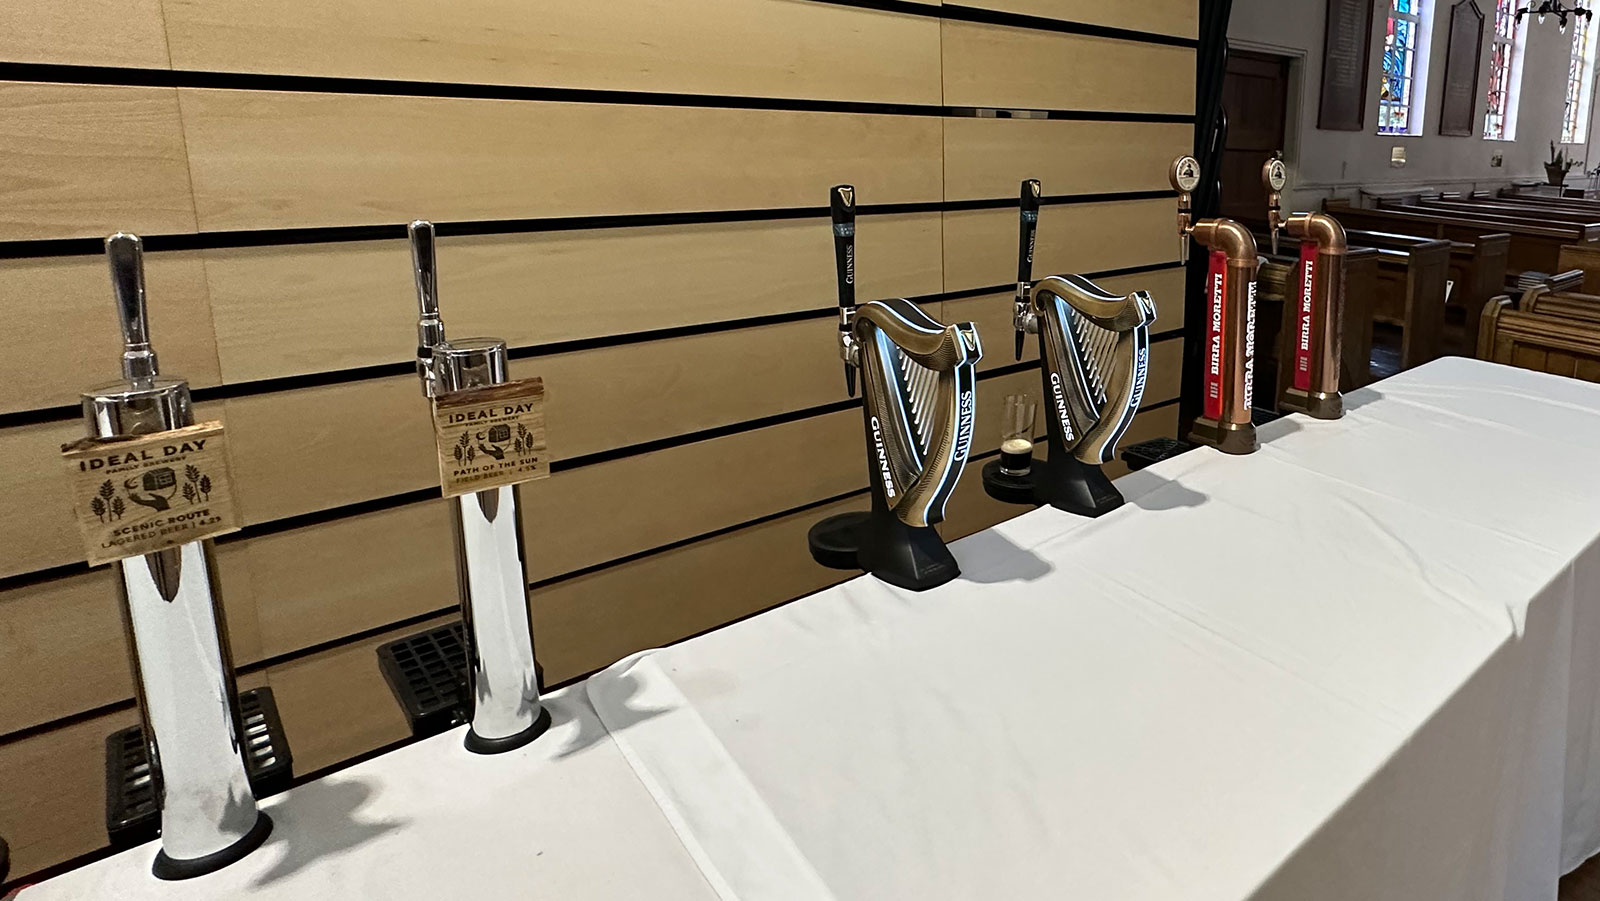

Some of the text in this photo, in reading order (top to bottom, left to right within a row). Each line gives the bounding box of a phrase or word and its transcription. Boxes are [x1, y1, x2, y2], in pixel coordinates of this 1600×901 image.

[846, 245, 854, 284] GUINNESS
[1213, 273, 1223, 332] MORETTI
[1303, 260, 1314, 313] MORETTI
[1301, 315, 1311, 351] BIRRA
[1211, 335, 1221, 375] BIRRA
[1130, 347, 1146, 408] GUINNESS
[449, 403, 534, 424] IDEAL DAY
[1050, 372, 1075, 442] GUINNESS
[954, 390, 972, 462] GUINNESS
[79, 439, 207, 472] IDEAL DAY
[106, 464, 140, 475] FAMILY
[453, 457, 538, 476] PATH OF THE SUN
[871, 416, 896, 499] GUINNESS
[456, 473, 481, 483] FIELD
[483, 470, 504, 479] BEER
[101, 530, 157, 549] LAGERED
[160, 523, 190, 537] BEER
[113, 508, 210, 537] SCENIC ROUTE
